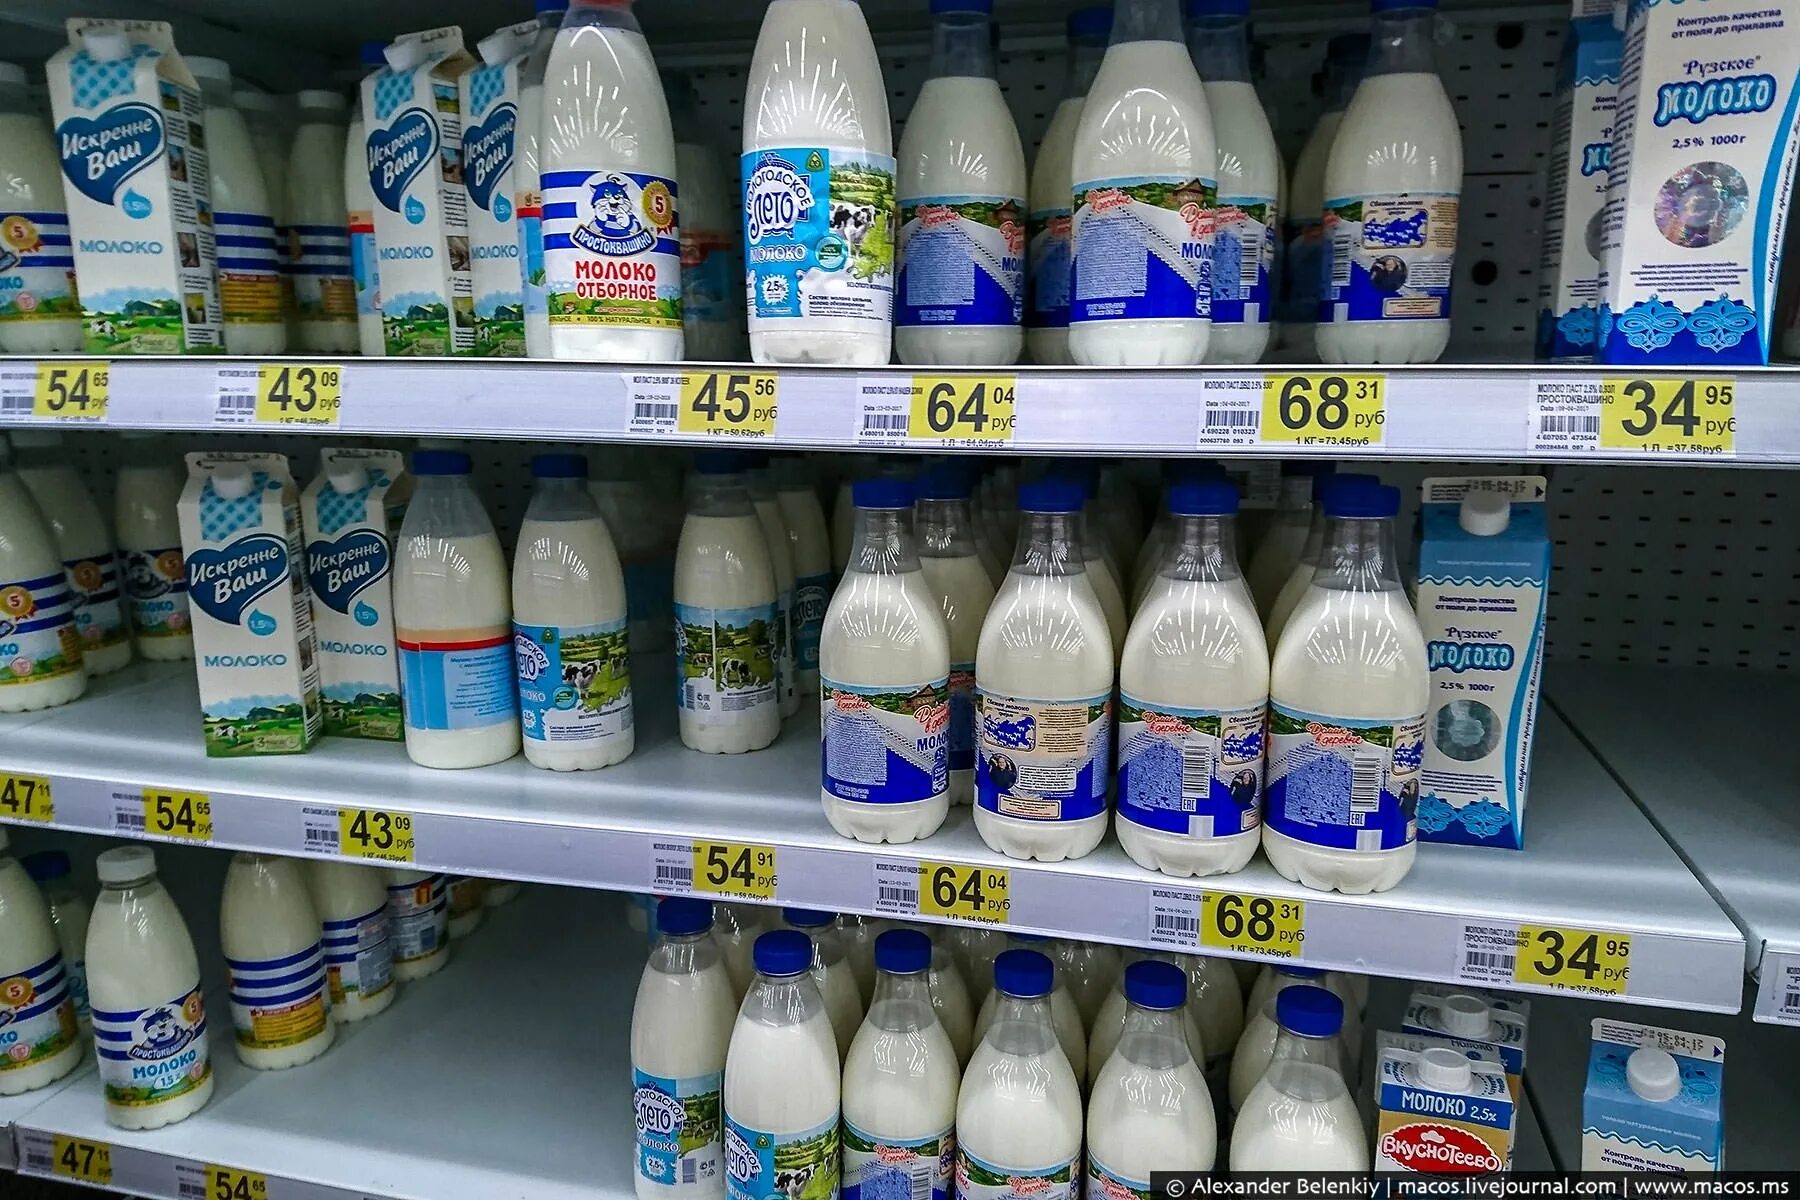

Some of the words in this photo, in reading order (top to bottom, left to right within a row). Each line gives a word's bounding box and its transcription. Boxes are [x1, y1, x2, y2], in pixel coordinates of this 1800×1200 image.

[1677, 15, 1730, 27] Контроль
[1733, 8, 1782, 21] качества
[1671, 30, 1685, 38] от
[1686, 27, 1713, 37] поля
[1714, 25, 1729, 35] до
[1731, 20, 1784, 34] прилавка
[61, 117, 154, 160] Искренне
[369, 122, 427, 167] Искренне
[1672, 137, 1704, 148] 2,5%
[87, 141, 142, 181] Ваш
[382, 146, 419, 189] Ваш
[475, 141, 507, 187] Ваш
[654, 195, 665, 213] 5
[79, 240, 163, 255] МОЛОКО
[575, 227, 652, 254] ПРОСТОКВАШИНО
[380, 246, 434, 259] МОЛОКО
[471, 245, 519, 259] МОЛОКО
[576, 261, 656, 282] МОЛОКО
[577, 282, 657, 301] ОТБОРНОЕ
[93, 372, 109, 387] 65
[321, 371, 338, 387] 09
[754, 379, 775, 396] 56
[47, 368, 90, 411] 54
[268, 367, 317, 413] 43
[692, 373, 751, 423] 45
[993, 387, 1014, 404] 04
[1355, 381, 1378, 399] 31
[1705, 385, 1733, 405] 95
[319, 396, 341, 411] руб
[927, 382, 989, 433] 64
[1279, 376, 1349, 430] 68
[1537, 395, 1615, 405] ПРОСТОКВАШИНО
[1621, 380, 1701, 437] 34
[753, 406, 778, 421] руб
[1354, 410, 1385, 428] руб
[191, 546, 279, 586] Искренне
[309, 541, 380, 574] Искренне
[214, 567, 268, 604] Ваш
[327, 560, 370, 593] Ваш
[320, 640, 388, 656] МОЛОКО
[204, 654, 288, 669] МОЛОКО
[1429, 643, 1513, 672] МОЛОКО
[1320, 735, 1362, 747] деревне
[1, 778, 35, 814] 47
[38, 784, 50, 796] 11
[156, 795, 196, 833] 54
[196, 801, 211, 815] 65
[349, 810, 394, 849] 43
[395, 816, 411, 830] 09
[396, 838, 416, 849] руб
[706, 845, 755, 887] 54
[757, 852, 773, 867] 91
[757, 875, 778, 888] руб
[932, 866, 985, 911] 64
[988, 874, 1007, 890] 04
[988, 898, 1011, 911] руб
[1280, 904, 1300, 920] 31
[1216, 894, 1275, 942] 68
[1279, 929, 1305, 944] руб
[1464, 934, 1530, 948] ПРОСТОКВАШИНО
[1534, 930, 1601, 980] 34
[1605, 940, 1630, 957] 95
[10, 986, 20, 998] 5
[133, 1049, 196, 1079] МОЛОКО
[1402, 1090, 1466, 1116] МОЛОКО
[1470, 1105, 1497, 1122] 2,5%
[62, 1142, 96, 1174] 47
[99, 1149, 110, 1161] 11
[1604, 1148, 1645, 1164] Контроль
[1647, 1158, 1686, 1173] качества
[1600, 1156, 1611, 1164] от
[1612, 1158, 1633, 1170] поля
[1633, 1163, 1645, 1173] до
[215, 1171, 251, 1200] 54
[253, 1181, 266, 1192] 65
